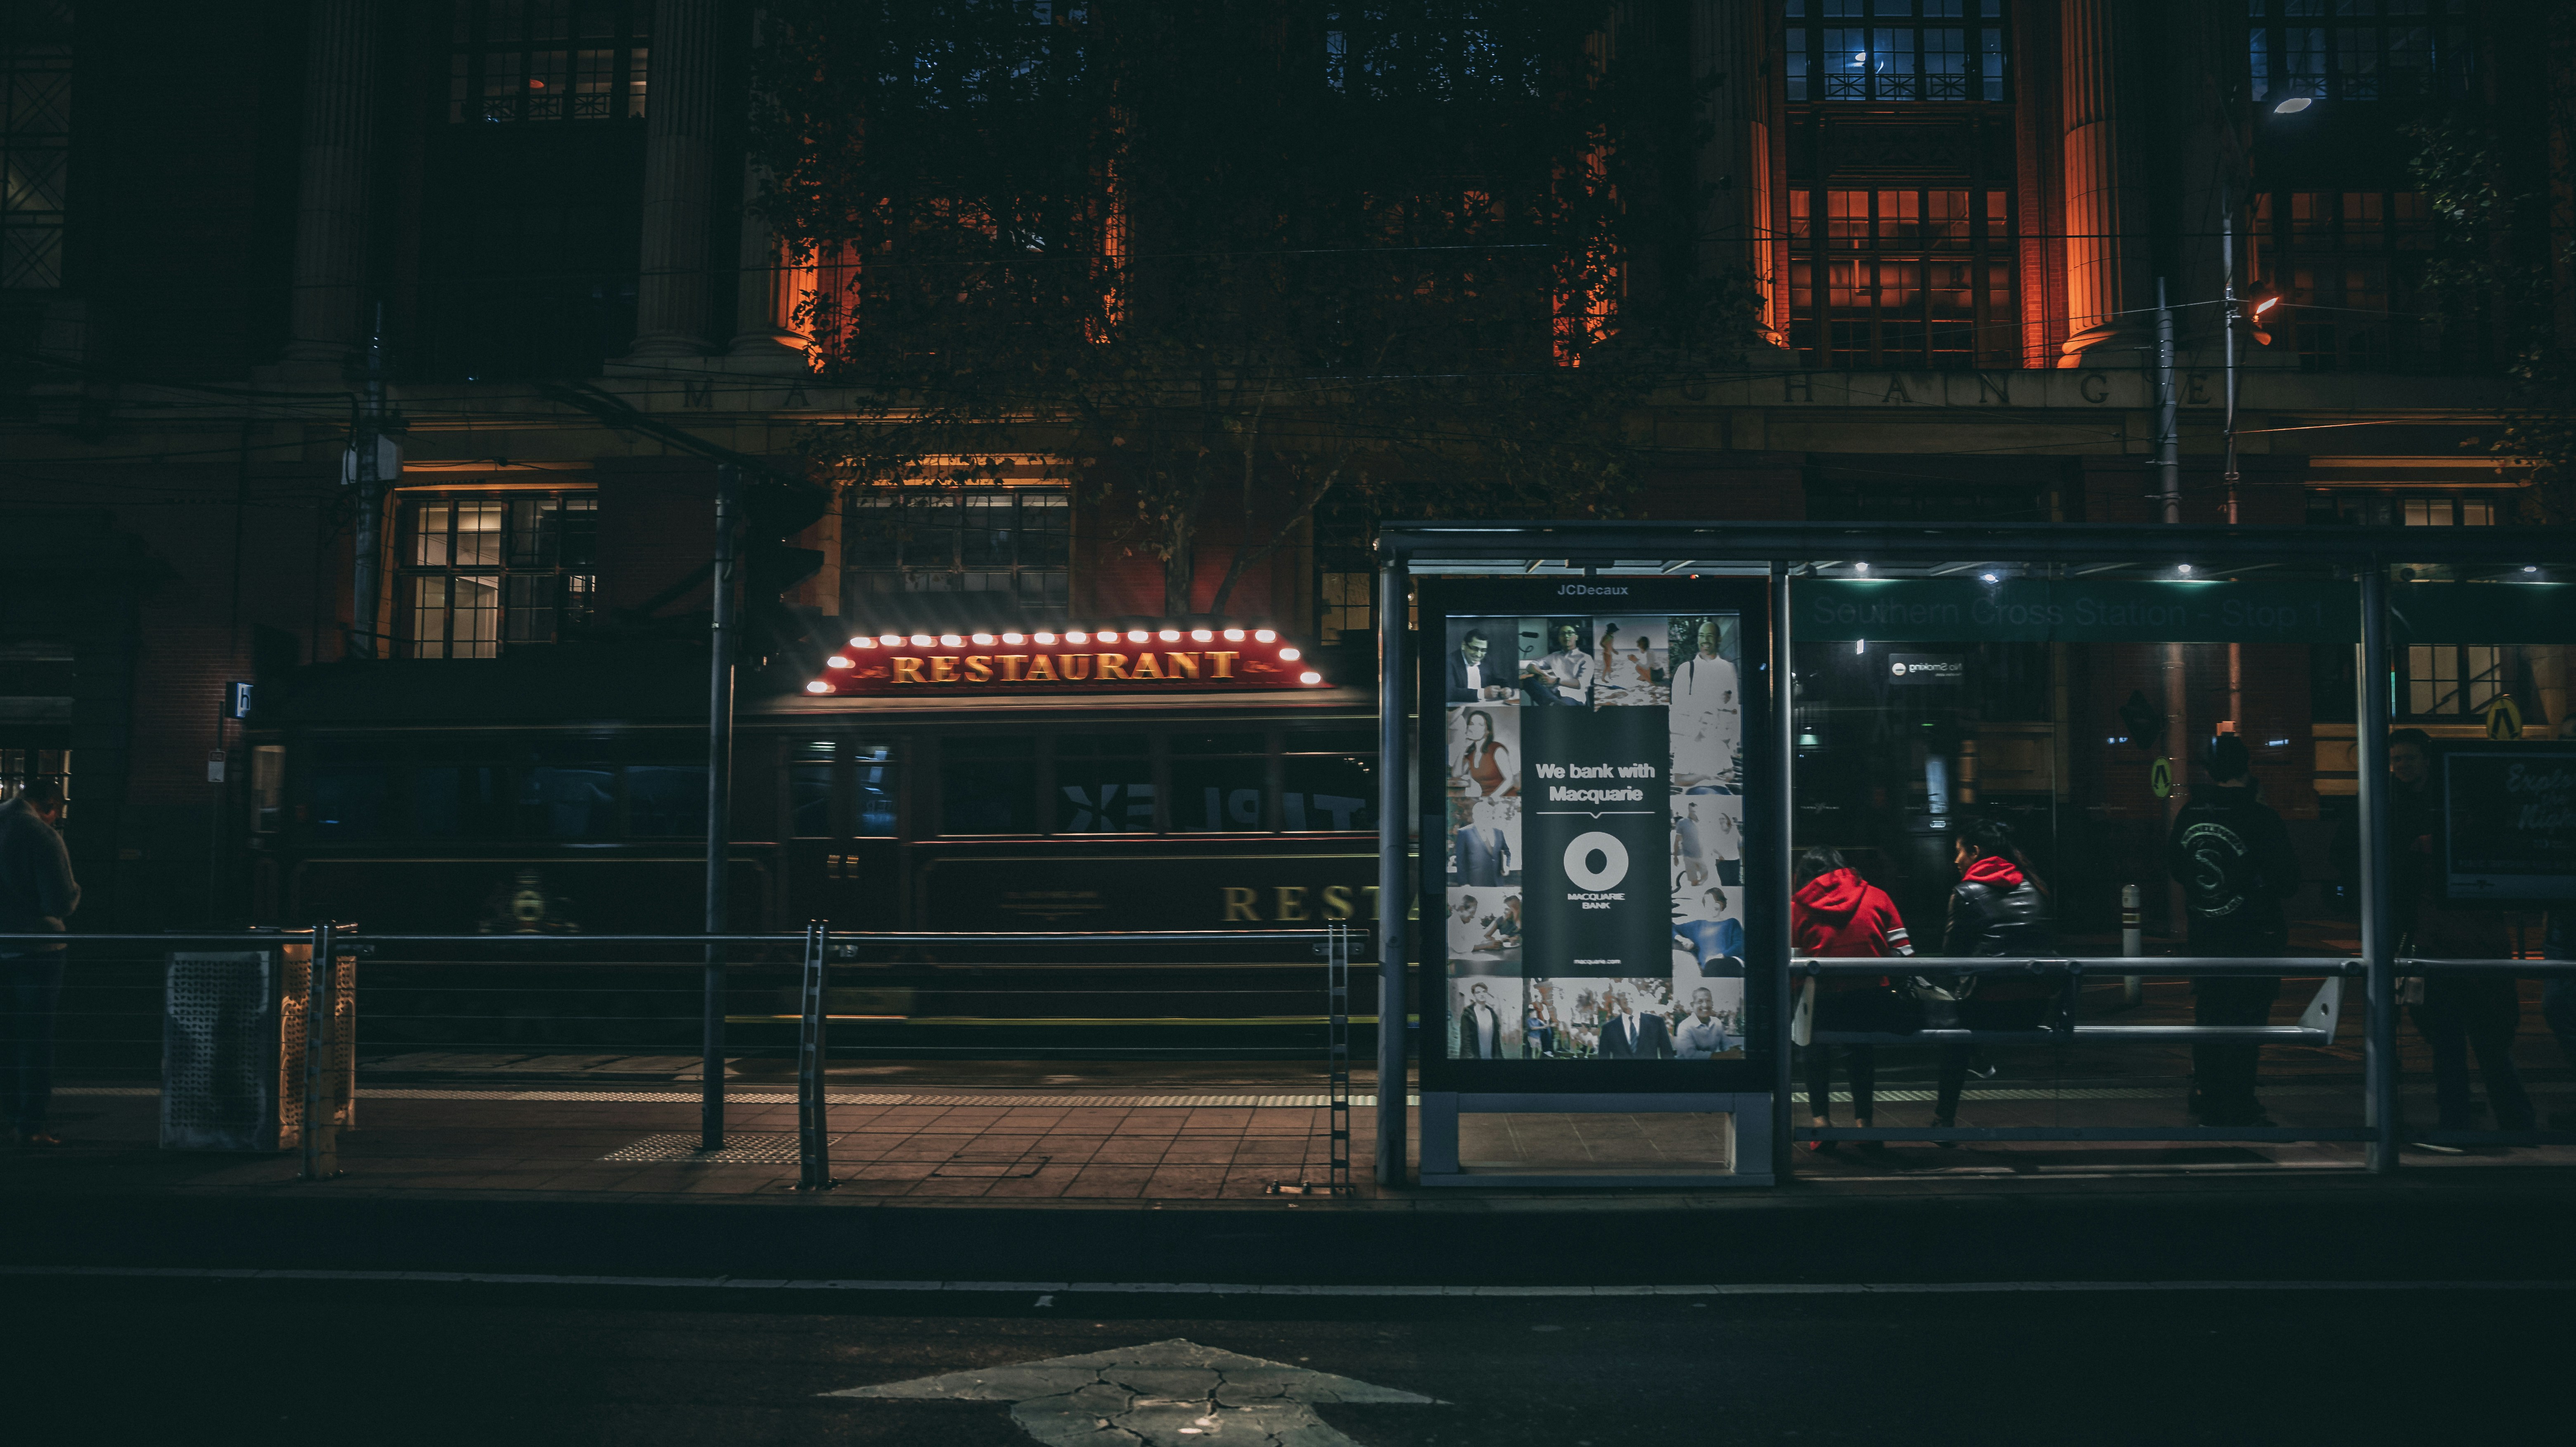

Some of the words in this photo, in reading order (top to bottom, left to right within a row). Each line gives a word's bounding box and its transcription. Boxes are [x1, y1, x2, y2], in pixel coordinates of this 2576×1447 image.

[1683, 371, 2212, 406] CHANGE
[1558, 585, 1629, 595] JCDecaux
[1814, 596, 1959, 625] Southern
[1972, 596, 2064, 625] Cross
[2074, 598, 2186, 626] Station
[2222, 599, 2297, 632] Stop
[2311, 601, 2323, 627] 1
[890, 650, 1240, 683] RESTAURANT
[1536, 764, 1565, 778] We
[1570, 763, 1614, 778] bank
[1618, 763, 1655, 778] with
[2506, 763, 2576, 795] Explo
[1550, 785, 1643, 804] Macquarie
